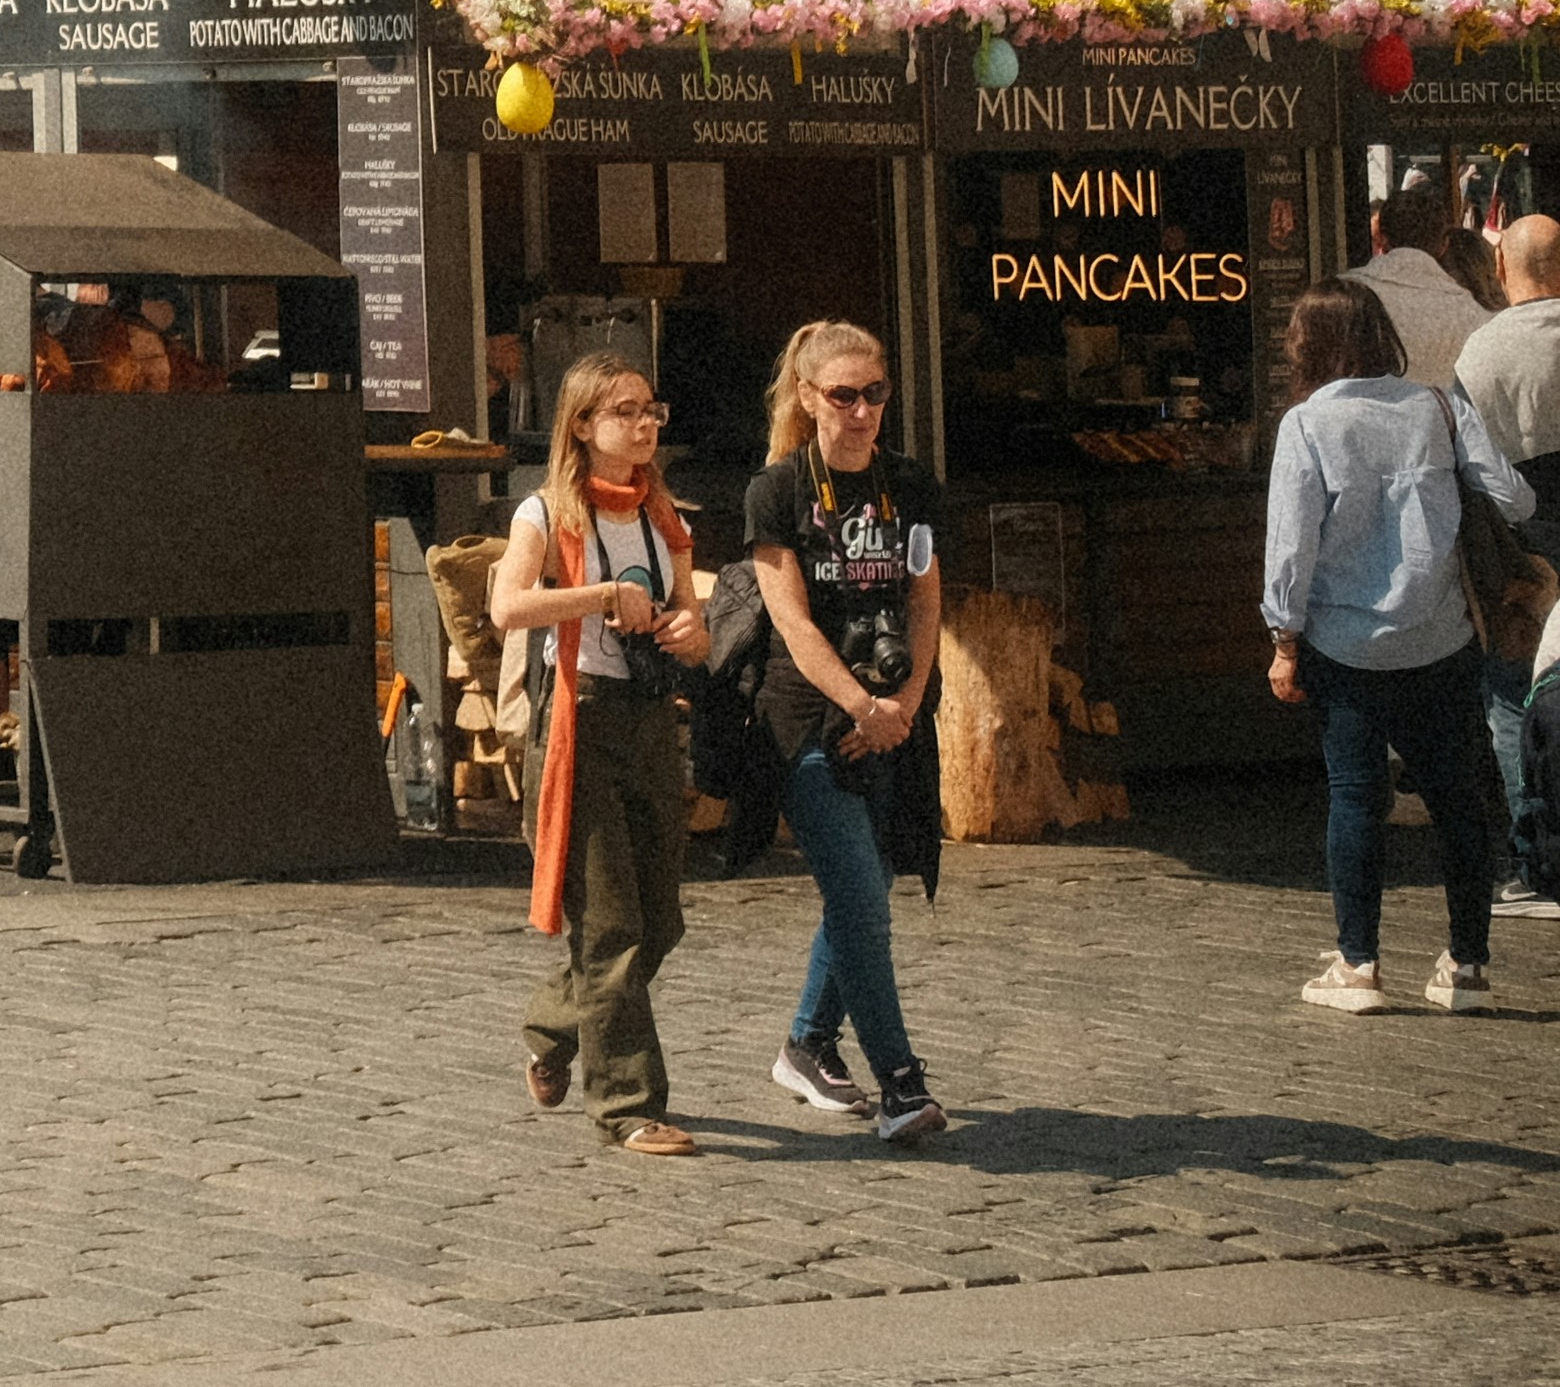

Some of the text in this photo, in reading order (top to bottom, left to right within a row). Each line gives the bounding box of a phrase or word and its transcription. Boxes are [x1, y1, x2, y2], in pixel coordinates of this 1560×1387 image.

[58, 21, 160, 51] SAUSAGE
[189, 13, 414, 47] POTATO WITH CABBAGE AND BACON
[1082, 47, 1197, 66] MINI PANCAKES
[437, 63, 663, 100] STARSKÁ ŠUNKA
[681, 66, 773, 102] KLOBÁSA
[811, 68, 895, 104] HALUŠKY
[975, 73, 1302, 132] MINI LÍVANEČKY
[590, 119, 630, 142] HAM
[692, 120, 769, 144] SAUSAGE
[1051, 169, 1157, 218] MINI
[991, 253, 1248, 302] PANCAKES
[815, 561, 841, 581] ICE
